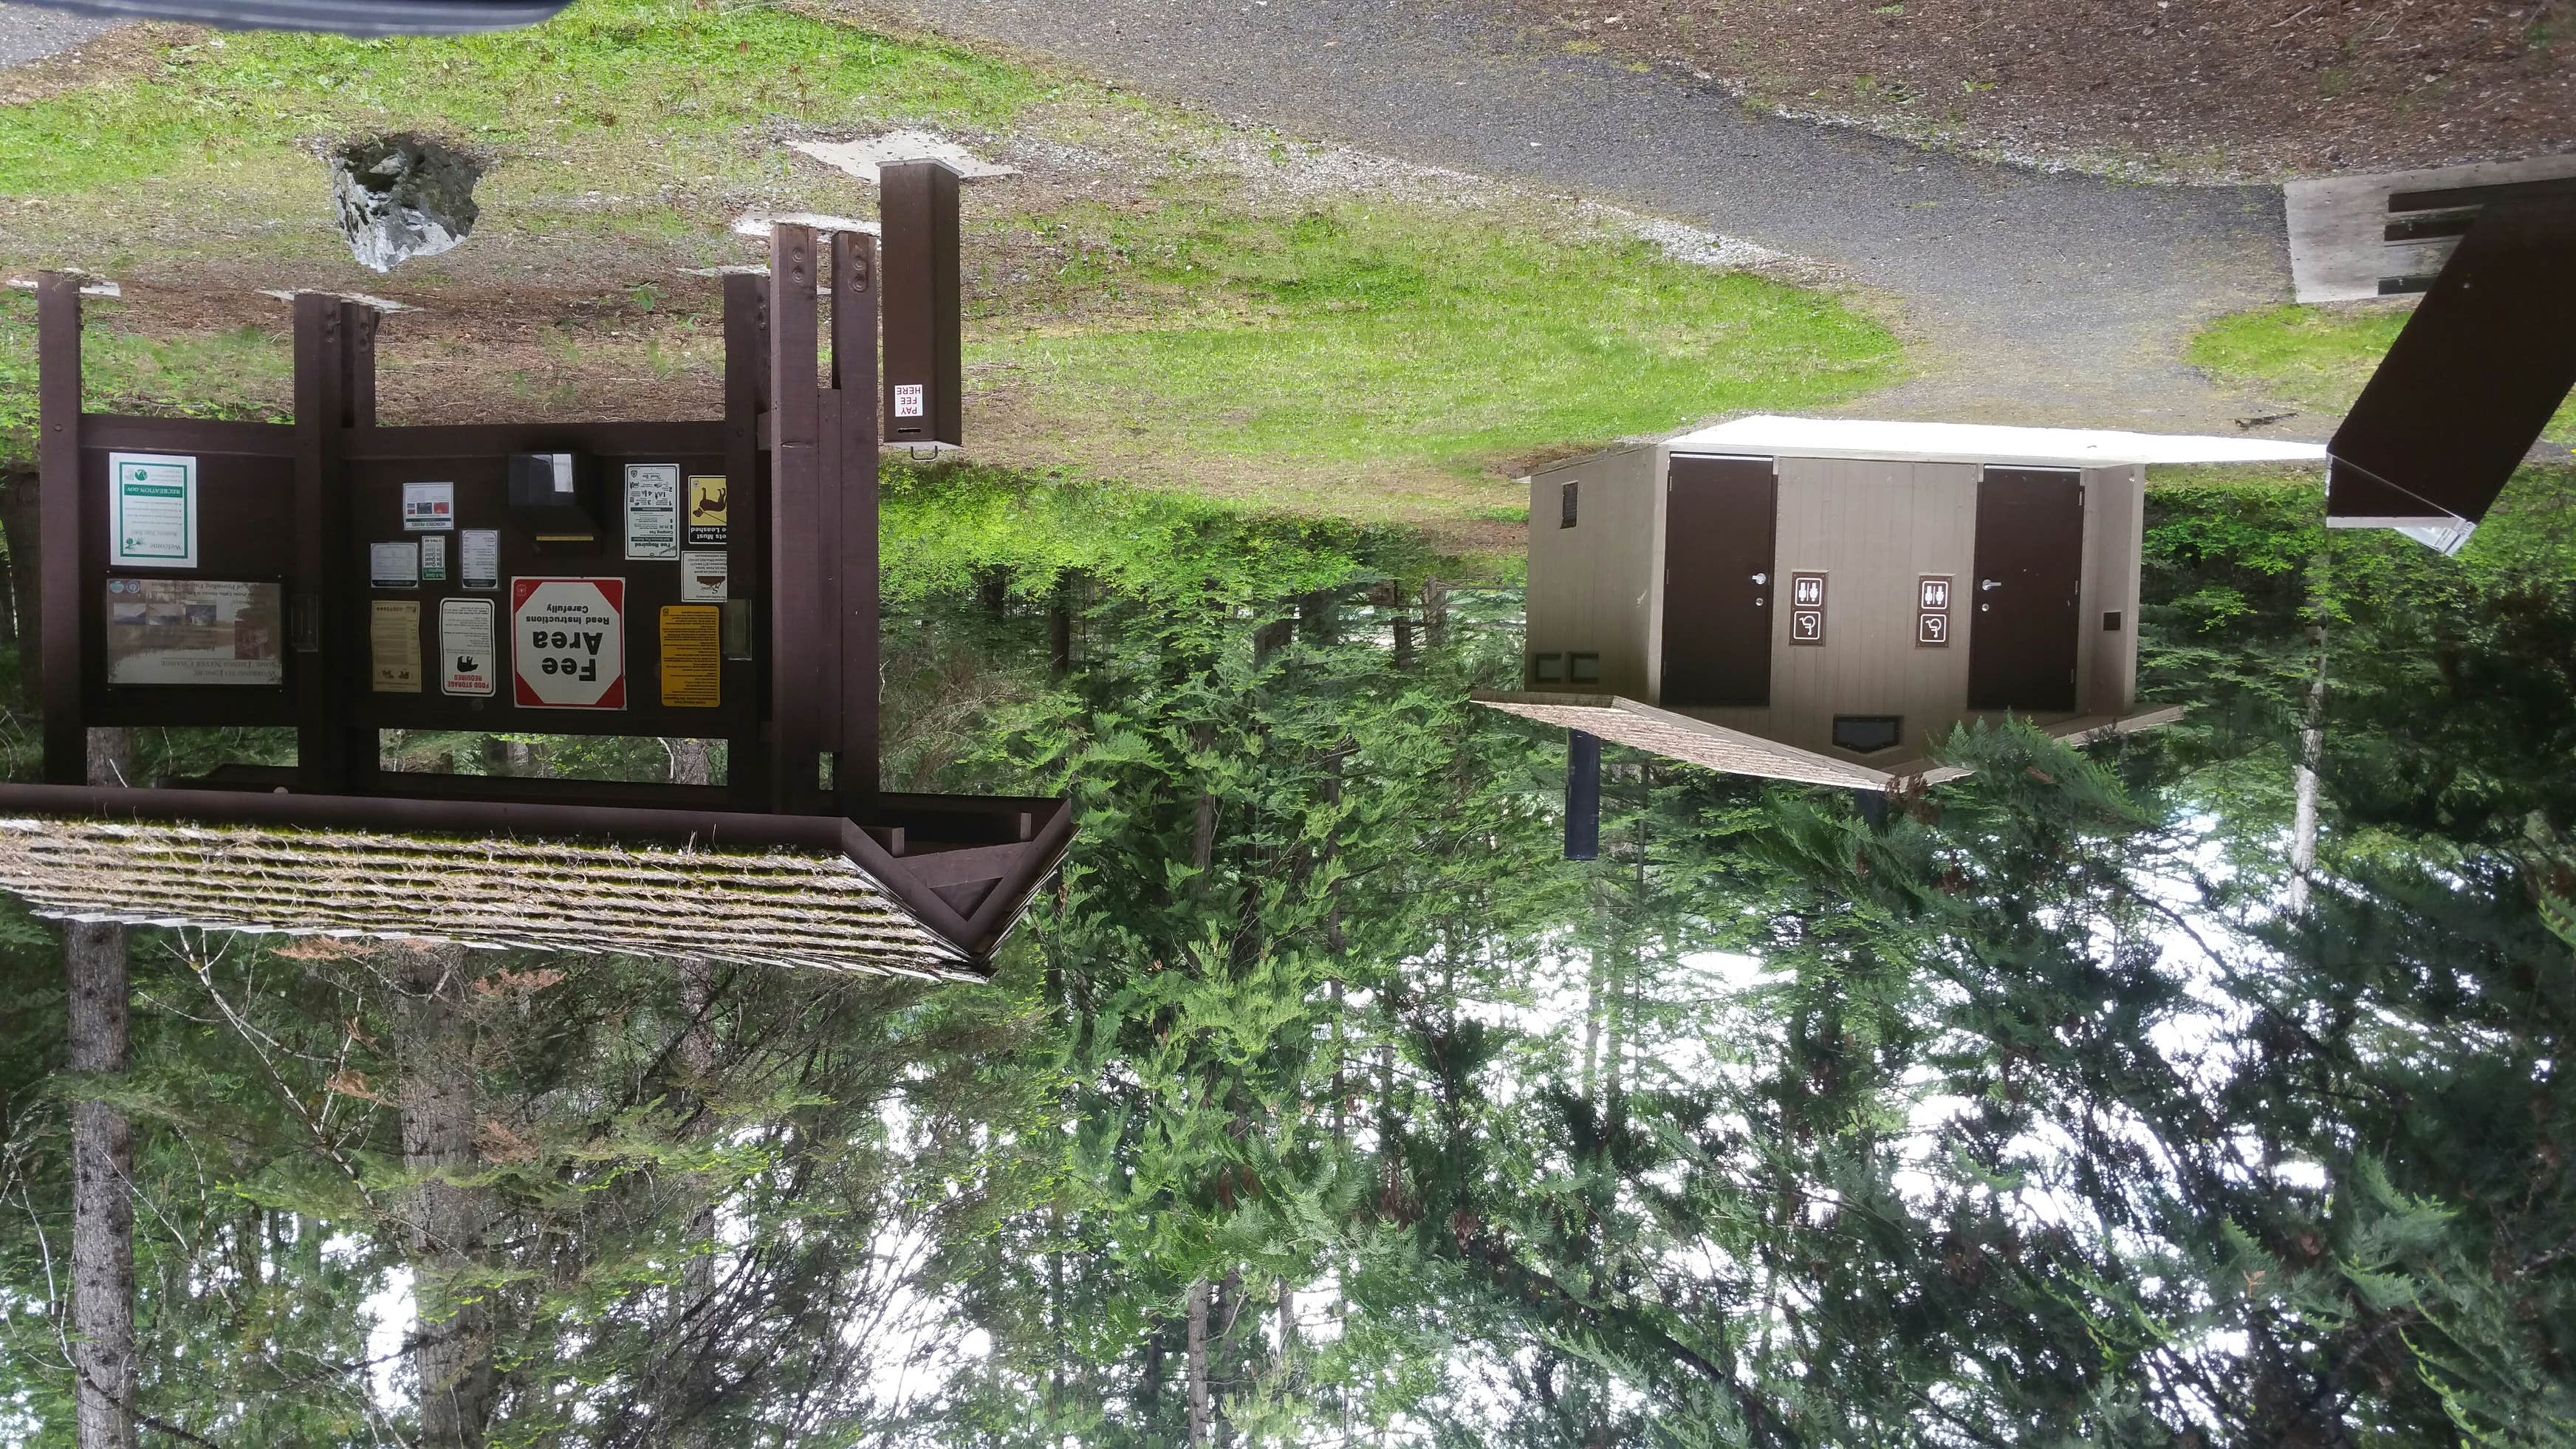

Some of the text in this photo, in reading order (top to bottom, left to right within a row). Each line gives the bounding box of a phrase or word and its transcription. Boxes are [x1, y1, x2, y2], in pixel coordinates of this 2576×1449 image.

[897, 387, 920, 395] HERE
[900, 397, 917, 405] FEE
[547, 603, 588, 613] Carefully
[526, 616, 609, 625] Read Instructions
[532, 631, 603, 655] Area
[541, 657, 596, 682] Fee
